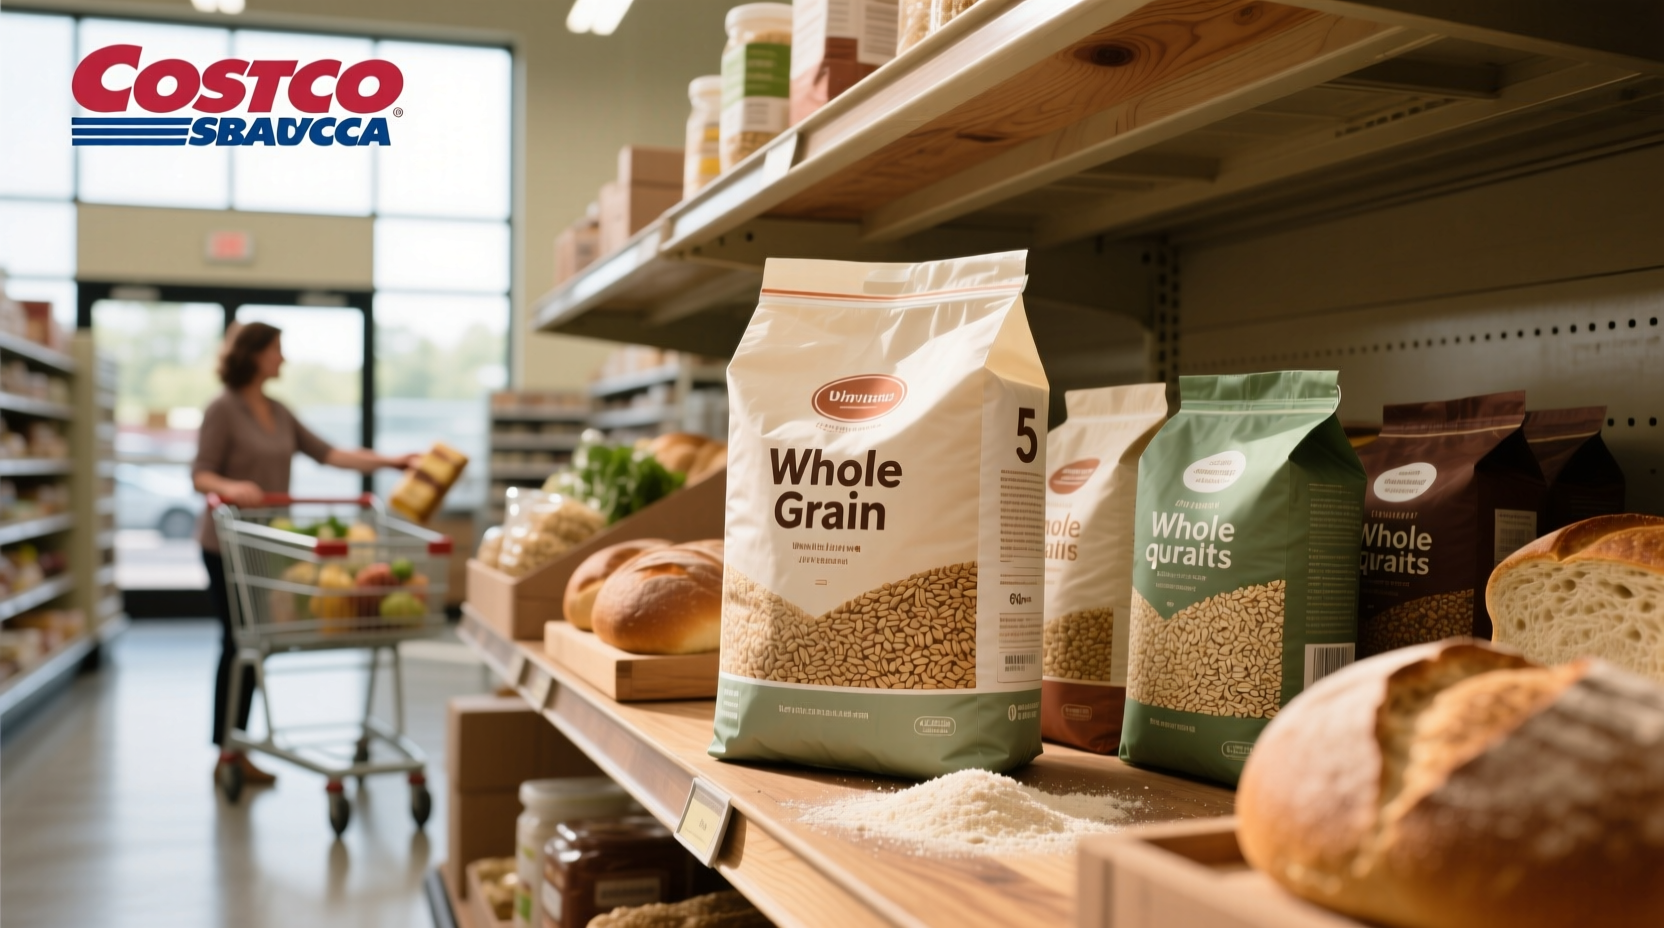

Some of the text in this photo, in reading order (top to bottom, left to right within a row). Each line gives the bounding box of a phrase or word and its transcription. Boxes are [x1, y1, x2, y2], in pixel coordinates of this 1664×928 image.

[1016, 406, 1038, 464] 5
[770, 448, 903, 489] Whole
[775, 491, 886, 531] Grain
[1152, 511, 1235, 543] Whole
[1145, 542, 1232, 569] quraits
